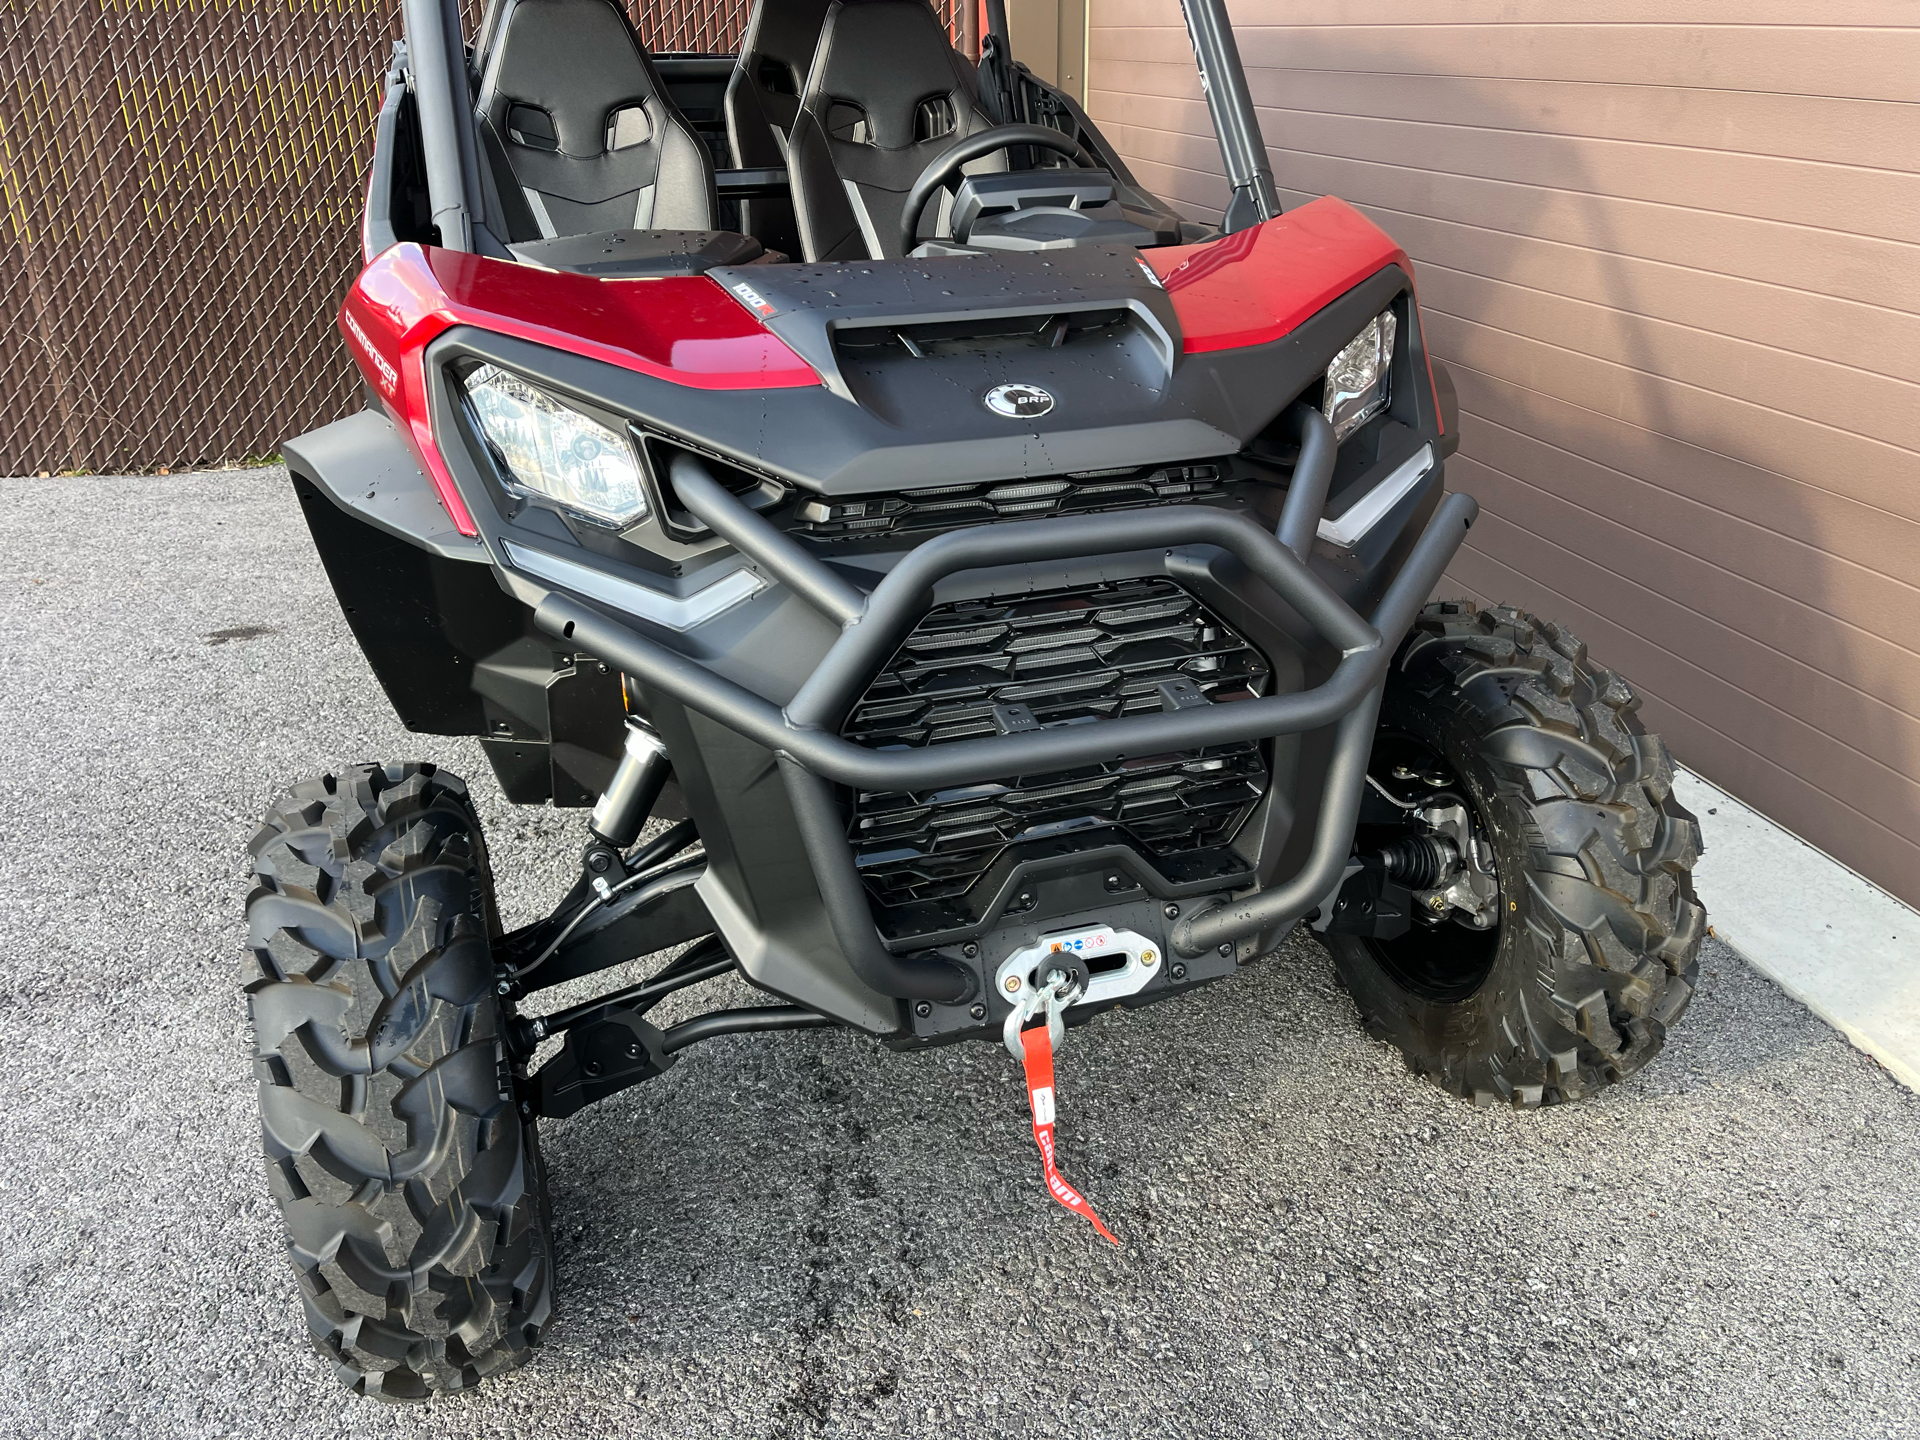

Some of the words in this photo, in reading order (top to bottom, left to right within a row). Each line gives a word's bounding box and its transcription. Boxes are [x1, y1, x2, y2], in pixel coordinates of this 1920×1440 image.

[733, 282, 775, 317] 1000R
[345, 309, 397, 387] COMMANDER
[1017, 396, 1050, 404] BRP
[1039, 1130, 1082, 1207] can-am
